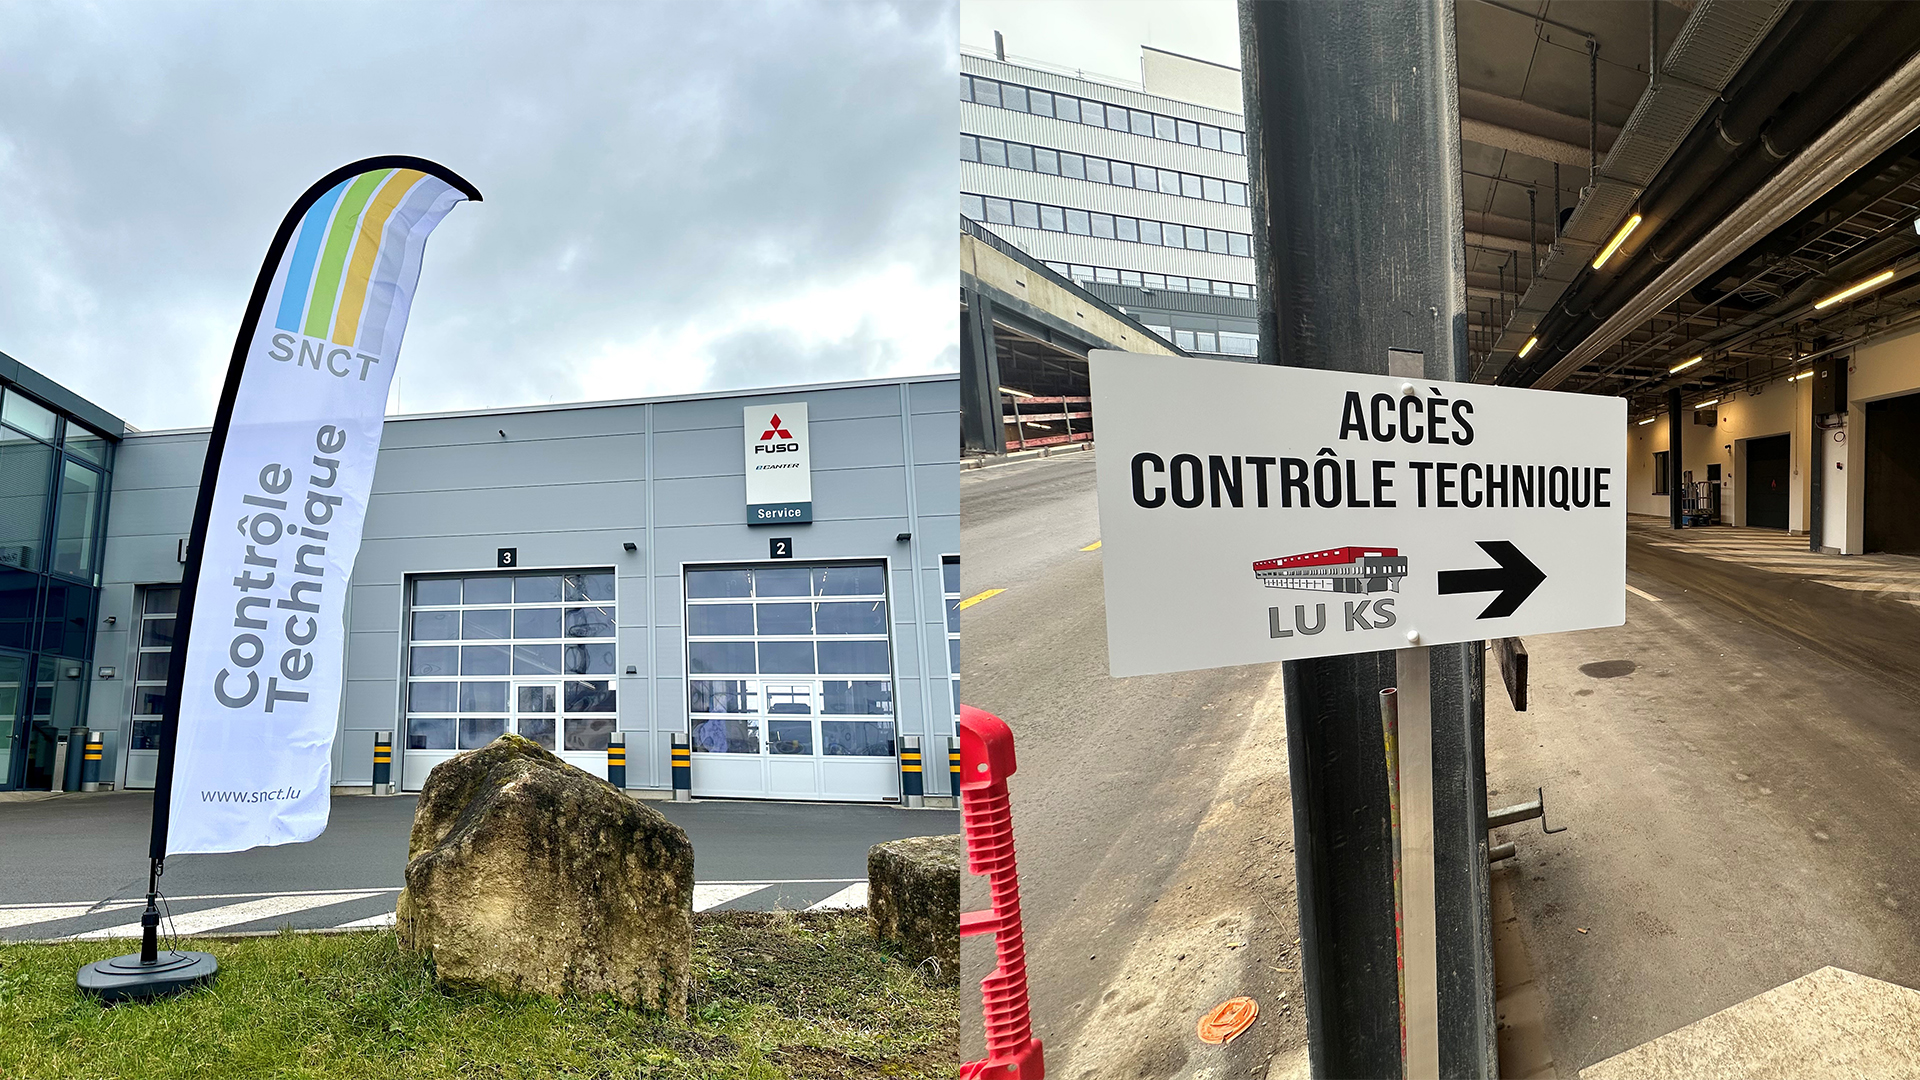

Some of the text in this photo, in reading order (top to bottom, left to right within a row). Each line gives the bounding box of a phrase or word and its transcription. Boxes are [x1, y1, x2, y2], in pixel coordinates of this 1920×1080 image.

[268, 333, 379, 381] SNCT
[1339, 387, 1475, 446] ACCÈS
[755, 443, 799, 454] FUSO
[1131, 447, 1611, 512] CONTRÔLE TECHNIQUE
[757, 507, 802, 519] Service
[264, 424, 346, 713] Technique
[503, 552, 511, 564] 3
[776, 542, 786, 555] 2
[214, 463, 293, 709] Contrôle
[1268, 597, 1397, 639] LU KS
[201, 786, 301, 803] www.snct.lu
